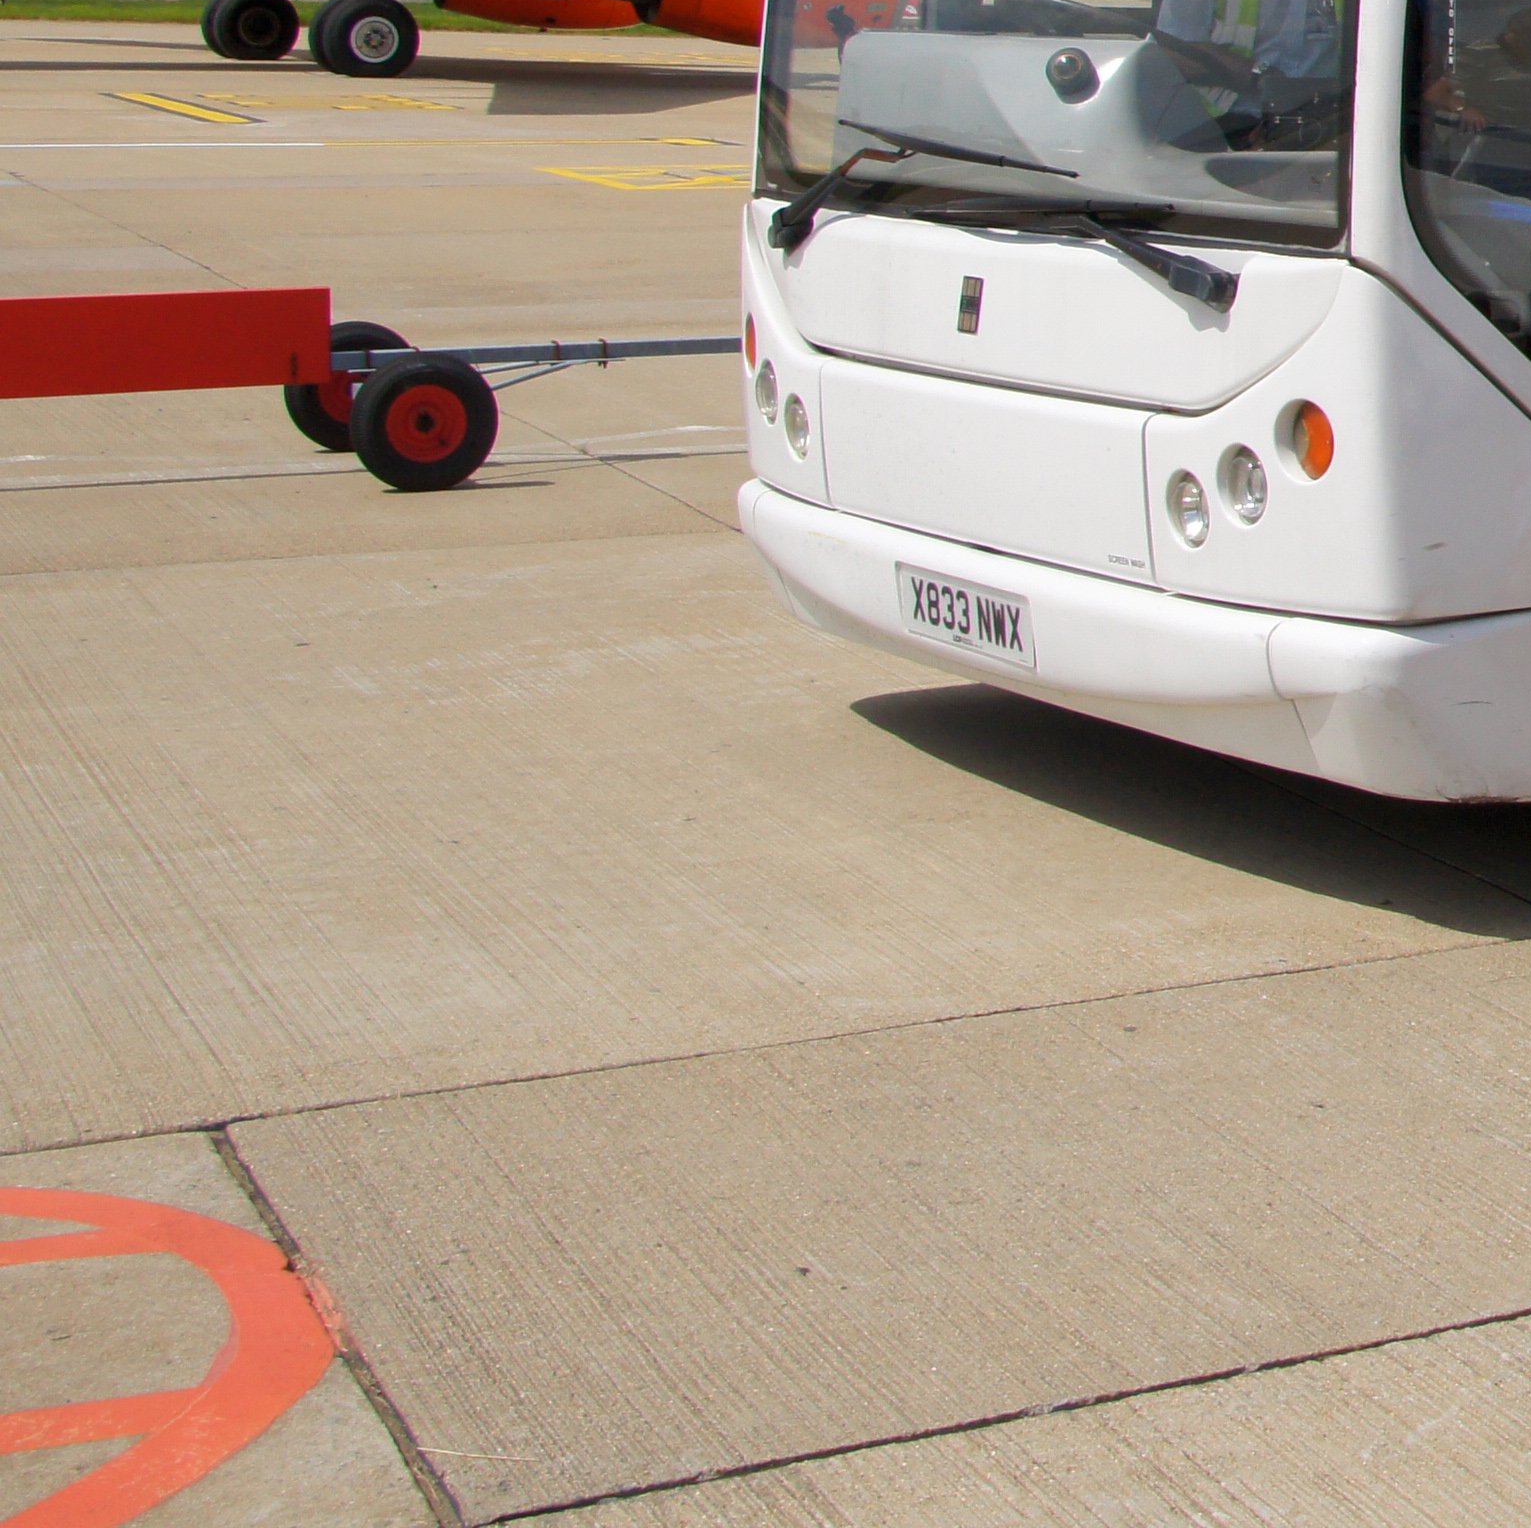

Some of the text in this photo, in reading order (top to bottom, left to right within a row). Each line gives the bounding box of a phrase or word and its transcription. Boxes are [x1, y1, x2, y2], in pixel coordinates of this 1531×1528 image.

[1448, 0, 1455, 18] TO
[1447, 27, 1455, 65] OPEN
[911, 576, 1024, 653] X833 NWX
